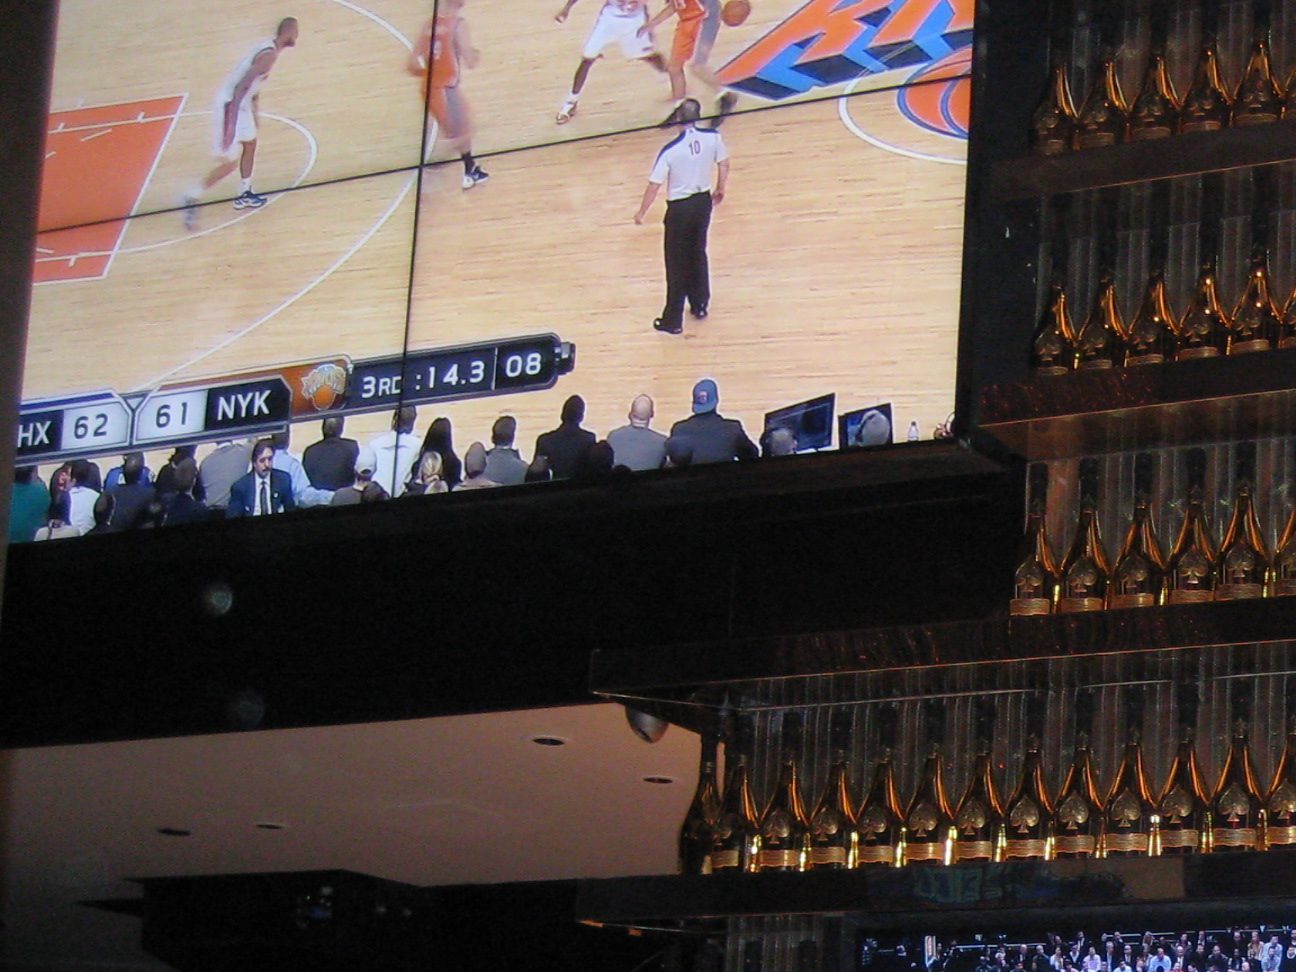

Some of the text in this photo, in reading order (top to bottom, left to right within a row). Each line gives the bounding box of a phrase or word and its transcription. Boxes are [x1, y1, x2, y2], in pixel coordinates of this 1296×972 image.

[74, 412, 109, 440] 62
[154, 401, 190, 430] 61
[217, 387, 272, 421] NYK
[361, 376, 403, 400] 3RD
[504, 352, 542, 379] 08
